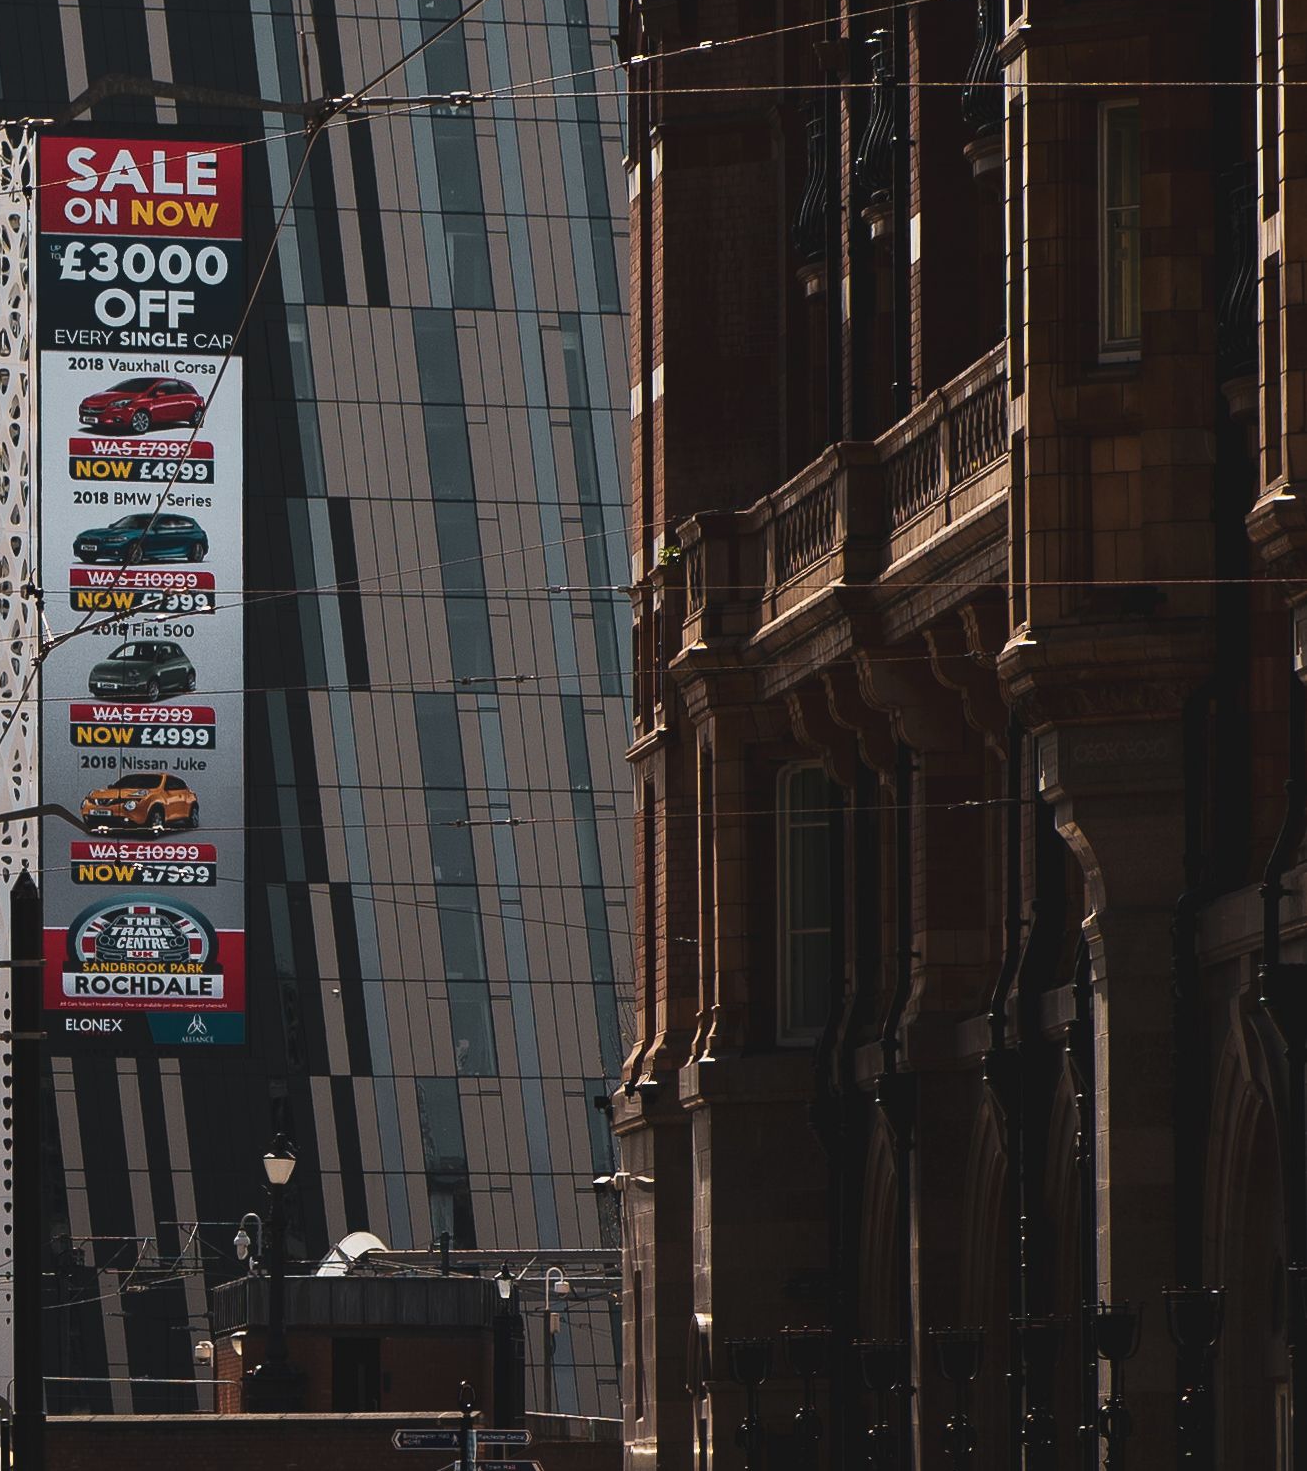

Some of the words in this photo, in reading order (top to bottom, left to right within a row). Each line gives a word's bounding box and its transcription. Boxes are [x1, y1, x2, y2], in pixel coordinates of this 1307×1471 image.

[67, 147, 217, 196] SALE
[64, 197, 118, 225] ON
[131, 199, 219, 228] NOW
[50, 245, 62, 253] UP
[59, 241, 228, 285] £3000
[94, 288, 195, 329] OFF
[55, 329, 114, 345] EVERY
[119, 331, 188, 348] SINGLE
[193, 334, 234, 349] CAR
[68, 357, 104, 371] 2018
[108, 358, 169, 373] Vauxhall
[173, 360, 216, 374] Corsa
[91, 440, 132, 455] WAS
[138, 441, 191, 457] £7999
[76, 460, 133, 479] NOW
[139, 462, 208, 480] £4999
[73, 491, 109, 505] 2018
[114, 493, 151, 506] BMW
[166, 493, 212, 507] Series
[87, 571, 129, 585] WAS
[134, 572, 198, 587] £10999
[77, 591, 135, 609] NOW
[141, 593, 209, 611] £7999
[92, 622, 126, 636] 2018
[132, 623, 159, 637] Fiat
[163, 625, 195, 638] 500
[92, 706, 134, 721] WAS
[139, 707, 193, 723] £7999
[77, 726, 134, 744] NOW
[140, 727, 209, 745] £4999
[80, 755, 117, 769] 2018
[121, 756, 168, 770] Nissan
[172, 757, 207, 771] Juke
[89, 844, 130, 859] WAS
[135, 845, 199, 860] £10999
[79, 864, 134, 881] NOW
[141, 865, 210, 884] £7999
[124, 917, 160, 925] THE
[110, 926, 175, 937] TRADE
[116, 937, 170, 950] CENTRE
[82, 963, 166, 973] SANDBROOK
[170, 963, 204, 973] PARK
[75, 975, 213, 995] ROCHDALE
[65, 1018, 123, 1032] ELONEX
